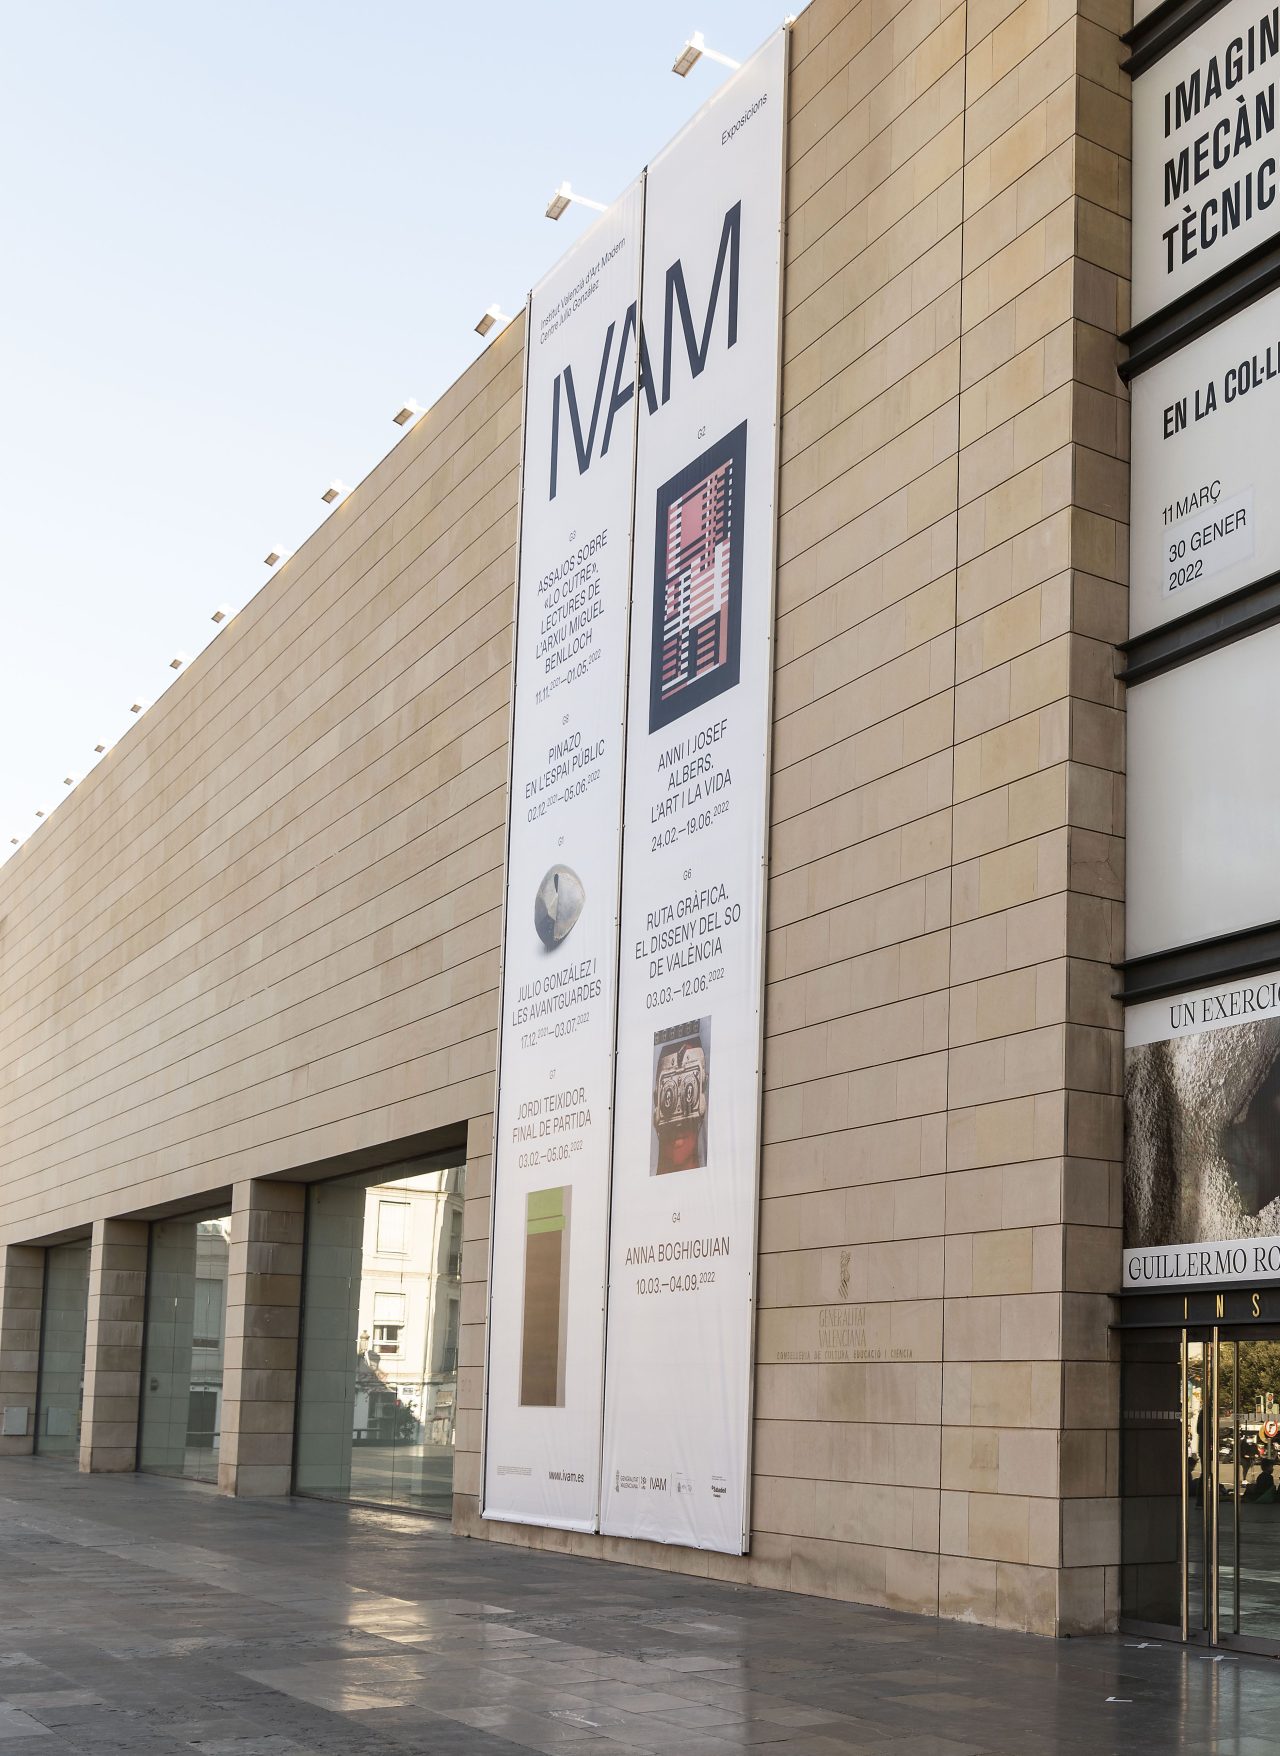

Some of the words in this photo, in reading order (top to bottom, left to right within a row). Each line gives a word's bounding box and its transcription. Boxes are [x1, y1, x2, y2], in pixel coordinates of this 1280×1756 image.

[721, 93, 767, 146] Exposicions
[541, 304, 561, 330] Institut
[601, 237, 626, 269] Modern
[540, 321, 559, 345] Centre
[559, 307, 572, 327] Julio
[550, 200, 741, 501] IVAM
[1163, 397, 1187, 440] EN
[1194, 381, 1218, 422] LA
[1162, 506, 1174, 526] 11
[1173, 479, 1222, 519] MARÇ
[1169, 539, 1186, 563] 30
[1190, 508, 1247, 550] GENER
[537, 556, 575, 596] ASSAJOS
[577, 528, 608, 566] SOBRE
[1169, 559, 1204, 592] 2022
[540, 590, 586, 635] LECTURES
[588, 578, 601, 597] DE
[536, 624, 567, 660] L'ARXIU
[569, 599, 605, 635] MIGUEL
[545, 627, 593, 675] BENLLOCH
[548, 731, 582, 764] PINAZO
[657, 742, 685, 773] ANNI
[692, 718, 728, 754] JOSEF
[525, 779, 537, 800] EN
[539, 760, 570, 792] L'ESPAI
[572, 739, 605, 772] PÚBLIC
[667, 753, 714, 792] ALBERS.
[651, 793, 680, 824] L'ART
[687, 783, 702, 806] LA
[704, 768, 732, 796] VIDA
[635, 939, 648, 960] EL
[650, 919, 697, 954] DISSENY
[699, 911, 722, 936] DEL
[724, 903, 741, 926] SO
[646, 904, 675, 931] RUTA
[649, 957, 664, 979] DE
[666, 936, 723, 973] VALÈNCIA
[517, 979, 542, 1003] JULIO
[543, 959, 592, 994] GONZÁLEZ
[512, 1006, 528, 1027] LES
[529, 979, 602, 1023] AVANTGUARDES
[1169, 1001, 1196, 1030] UN
[512, 1122, 537, 1145] FINAL
[539, 1118, 551, 1136] DE
[553, 1108, 592, 1134] PARTIDA
[517, 1099, 542, 1122] JORDI
[672, 1211, 681, 1224] G4
[625, 1245, 655, 1266] ANNA
[658, 1236, 730, 1263] BOGHIGUIAN
[1128, 1247, 1247, 1281] GUILLERMO
[818, 1329, 867, 1348] VALENCIANA
[819, 1307, 866, 1328] GENERALITAT
[549, 1469, 585, 1483] www.ivam.es
[649, 1477, 667, 1491] IVAM
